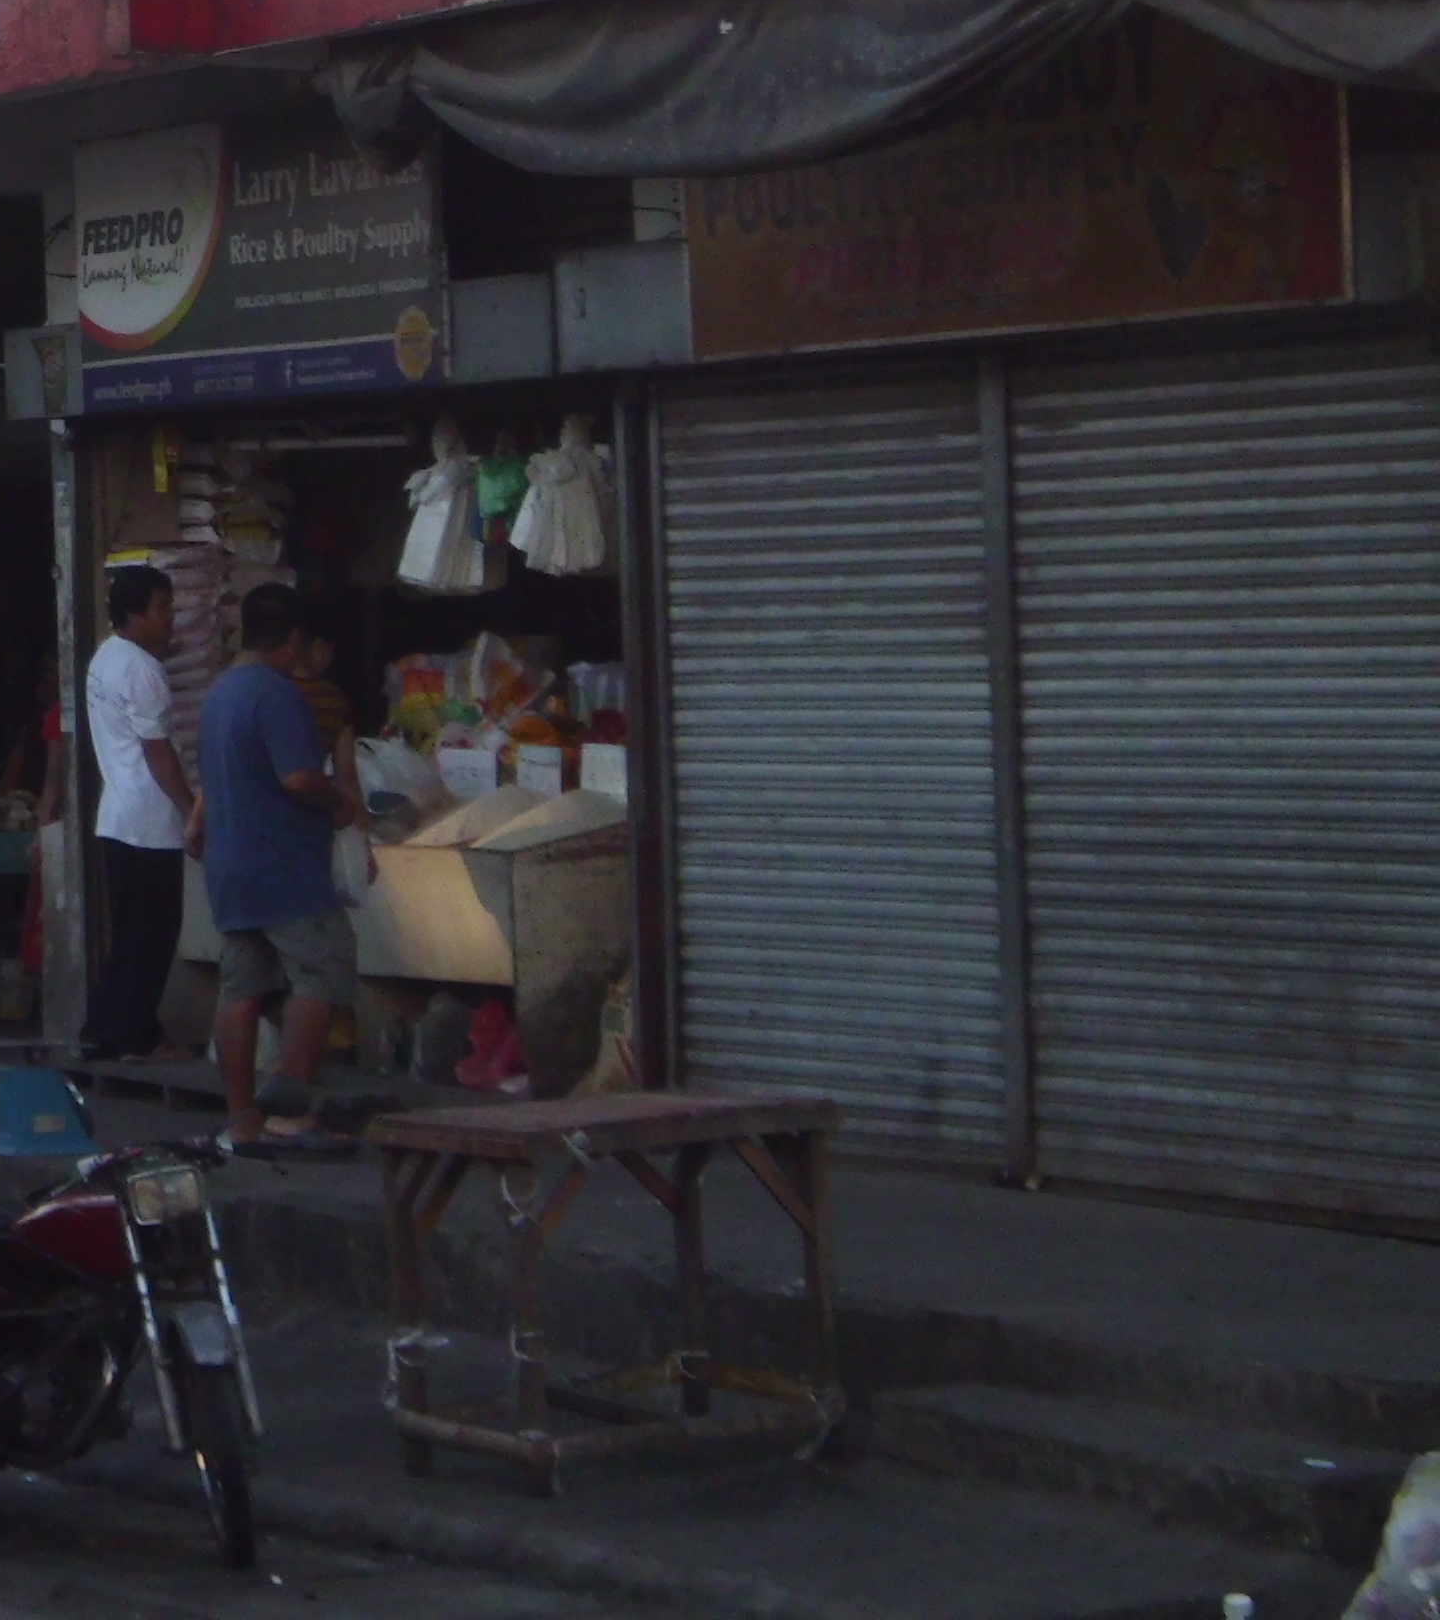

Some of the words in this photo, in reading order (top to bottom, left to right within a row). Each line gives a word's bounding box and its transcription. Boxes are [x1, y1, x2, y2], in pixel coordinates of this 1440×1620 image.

[232, 160, 300, 218] Larry
[82, 208, 185, 256] FEEDPRO
[230, 233, 267, 265] Rice
[273, 234, 288, 262] &
[293, 223, 359, 264] Poultry
[363, 209, 432, 258] Supply
